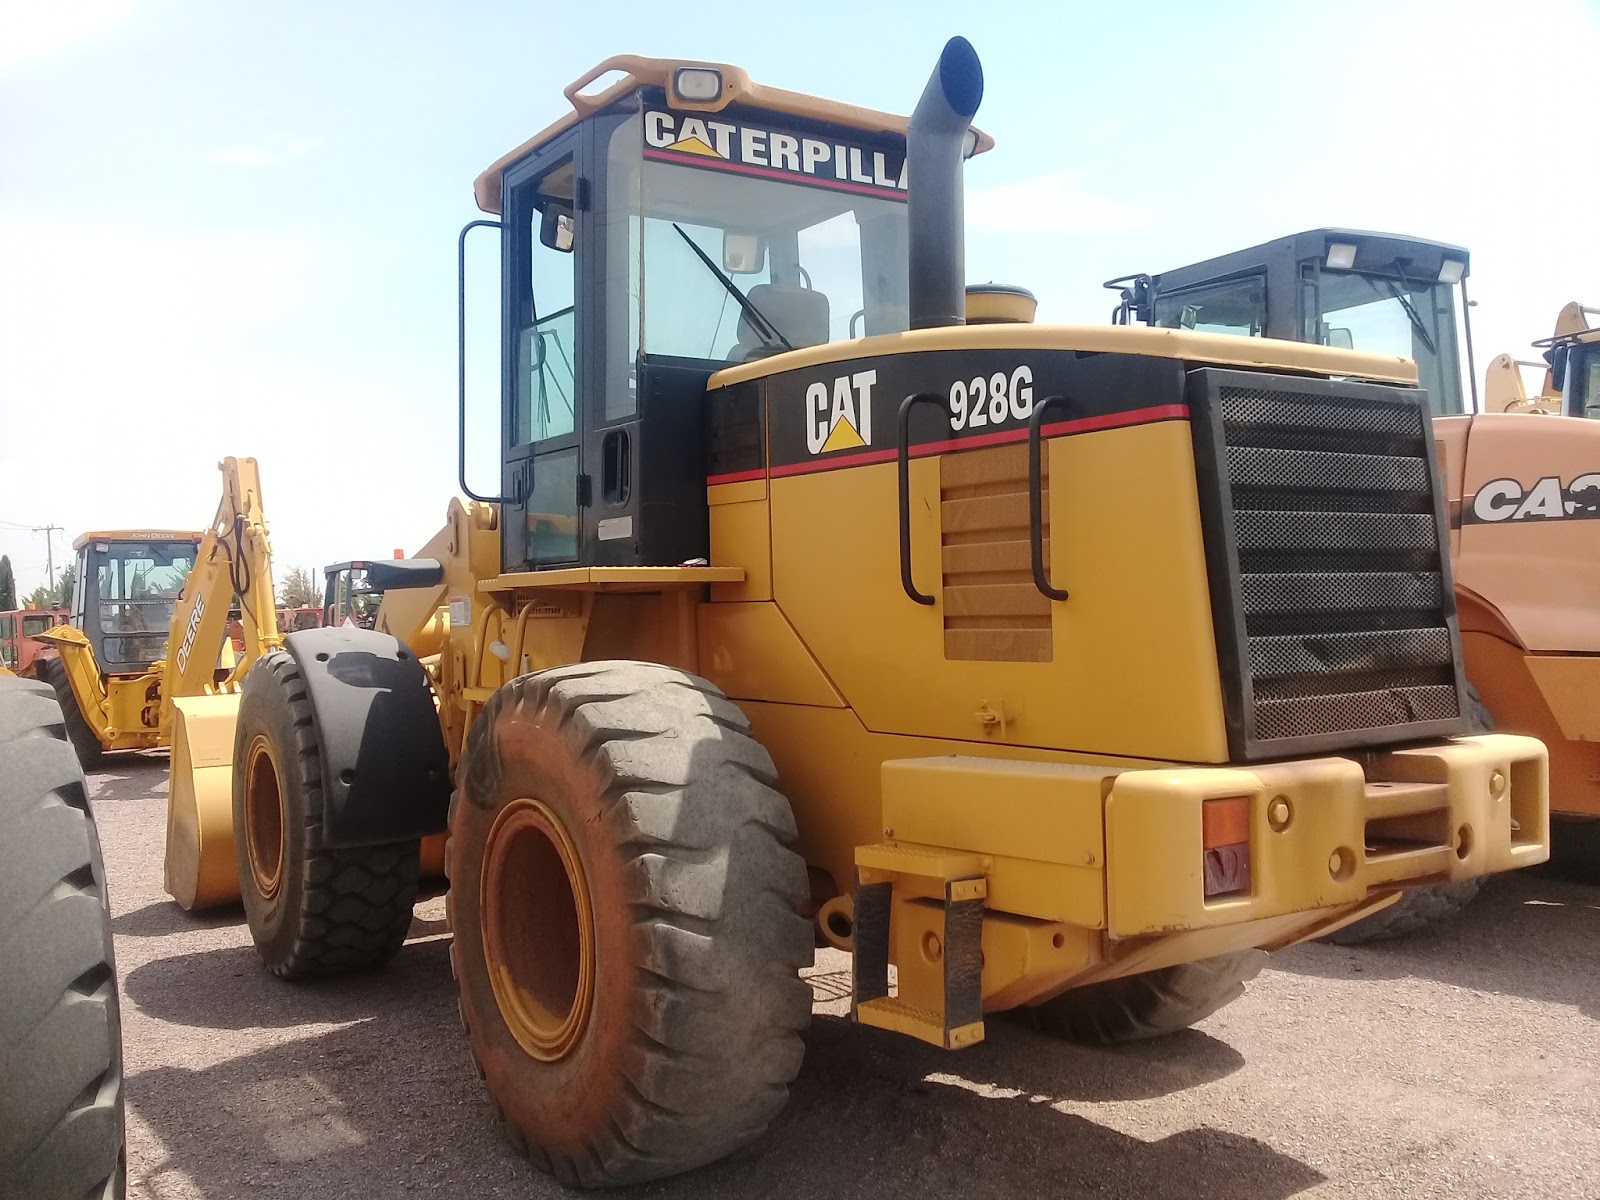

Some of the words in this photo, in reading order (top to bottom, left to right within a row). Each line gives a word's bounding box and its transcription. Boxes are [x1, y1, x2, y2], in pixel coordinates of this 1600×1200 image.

[805, 369, 877, 455] CAT
[949, 365, 1033, 431] 928G
[176, 592, 205, 677] DEERE
